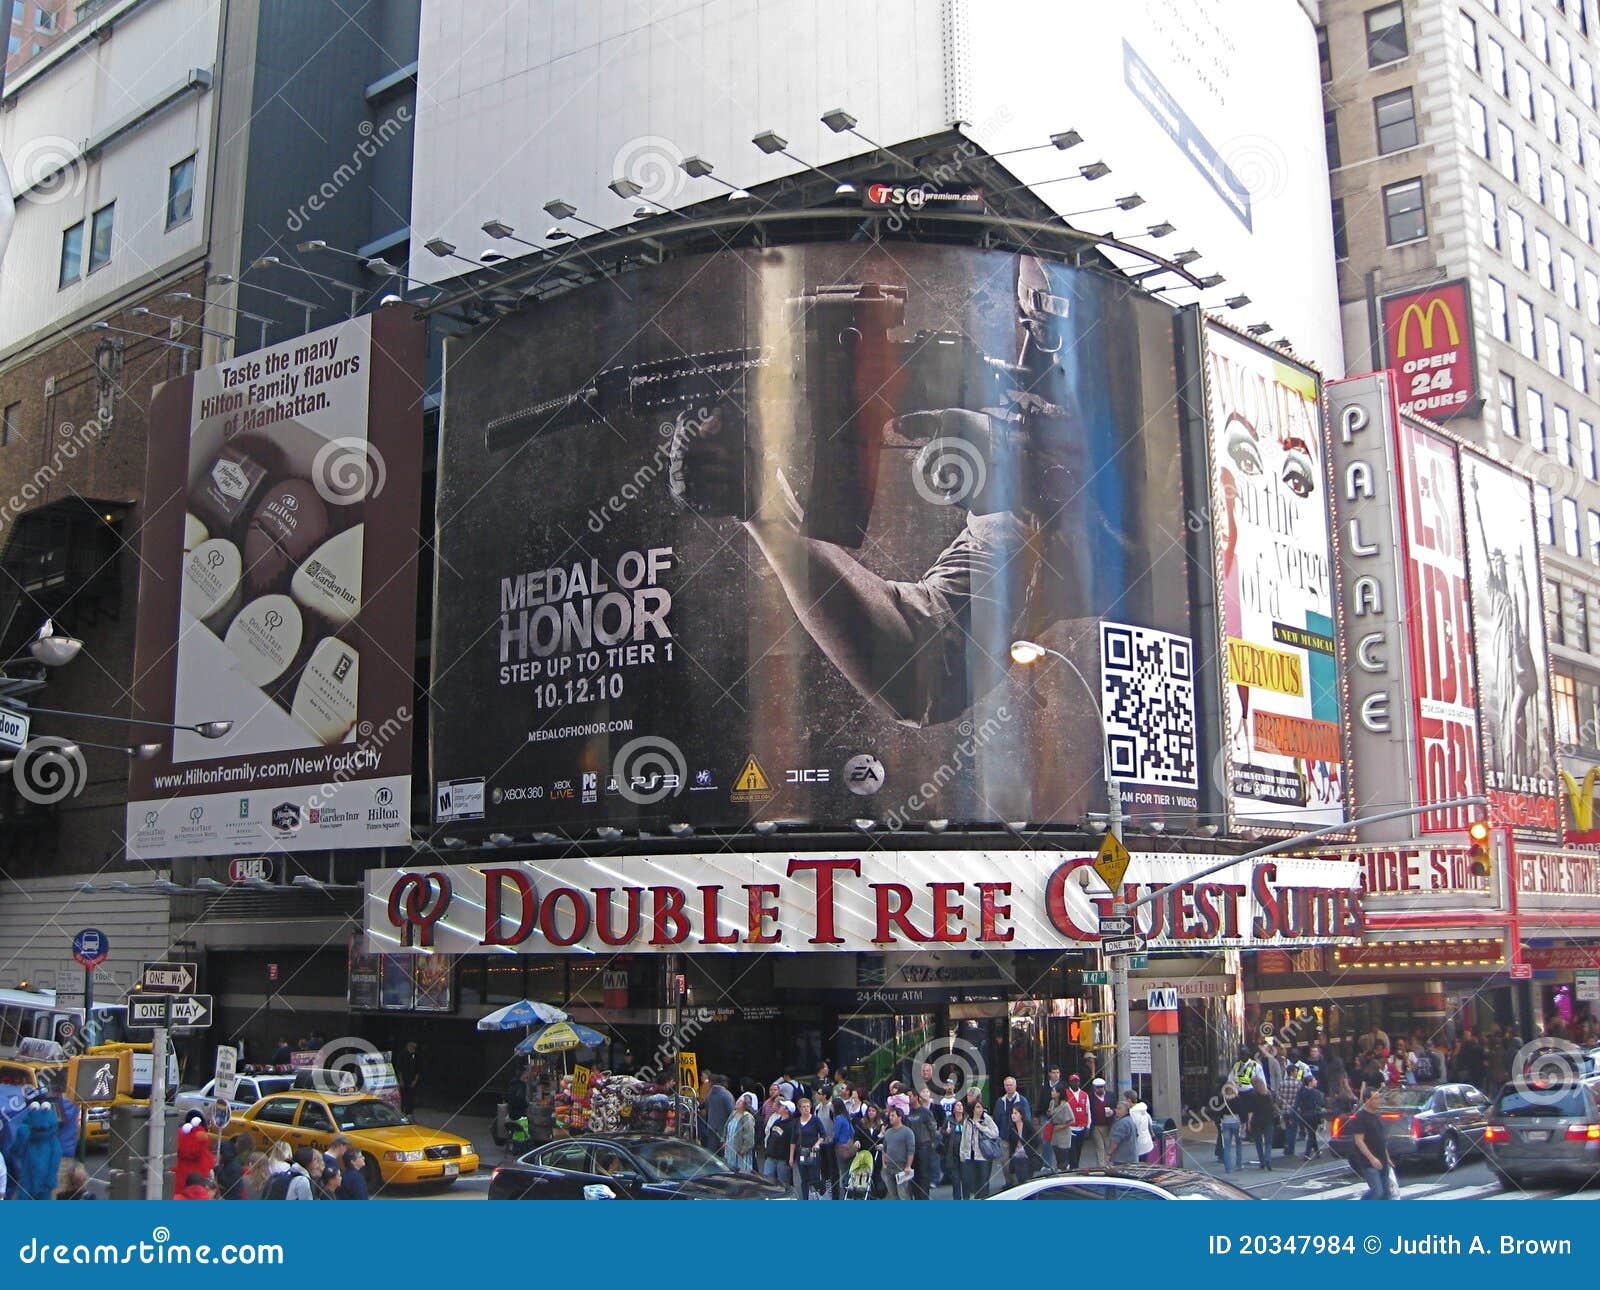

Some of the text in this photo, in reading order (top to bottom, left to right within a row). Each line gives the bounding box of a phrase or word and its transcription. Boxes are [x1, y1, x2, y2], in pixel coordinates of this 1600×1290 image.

[925, 191, 979, 201] premium.com
[222, 336, 339, 388] Taste the many
[1403, 351, 1457, 374] OPEN
[200, 355, 360, 420] Hilton Family flavors
[1411, 369, 1453, 396] 24
[1399, 390, 1468, 413] HOURS
[223, 391, 331, 437] of Manhattan.
[1341, 403, 1392, 733] PALACE
[314, 572, 341, 595] Garden
[340, 588, 357, 605] Inn
[500, 546, 673, 612] MEDAL OF
[500, 587, 673, 663] HONOR
[1273, 627, 1334, 652] A NEW MUSICAL
[500, 643, 673, 685] STEP UP TO TIER 1
[1228, 642, 1300, 694] NERVOUS
[534, 673, 624, 709] 10.12.10
[528, 719, 633, 742] MEDALOFHONOR.COM
[1254, 711, 1341, 763] BREAKDOWN
[154, 750, 382, 788] www.HiltonFamily.com/NewYorkCity
[851, 766, 878, 782] EA
[553, 780, 571, 790] XBOX
[582, 773, 597, 790] PC
[631, 774, 680, 789] PS3
[1261, 784, 1297, 799] BELASCO
[1489, 770, 1555, 796] AT LARGE
[440, 792, 451, 811] M
[550, 789, 575, 800] LIVE
[1136, 792, 1153, 805] FOR
[1154, 794, 1170, 806] TIER
[1177, 796, 1197, 808] VIDEO
[320, 811, 359, 823] Garden Inn
[368, 807, 399, 821] Hilton
[382, 821, 400, 831] Square
[1539, 855, 1565, 892] SIDE
[1046, 856, 1247, 942] GUEST
[1252, 862, 1364, 939] SUITES
[1103, 922, 1113, 930] ONE
[1109, 940, 1140, 950] ONE WAY
[1132, 957, 1138, 969] 7
[149, 972, 187, 985] ONE WAY
[1089, 973, 1098, 984] 47
[901, 990, 923, 1001] ATM
[141, 1005, 200, 1018] ONE WAY
[577, 1074, 587, 1083] 10
[681, 1067, 695, 1088] 10
